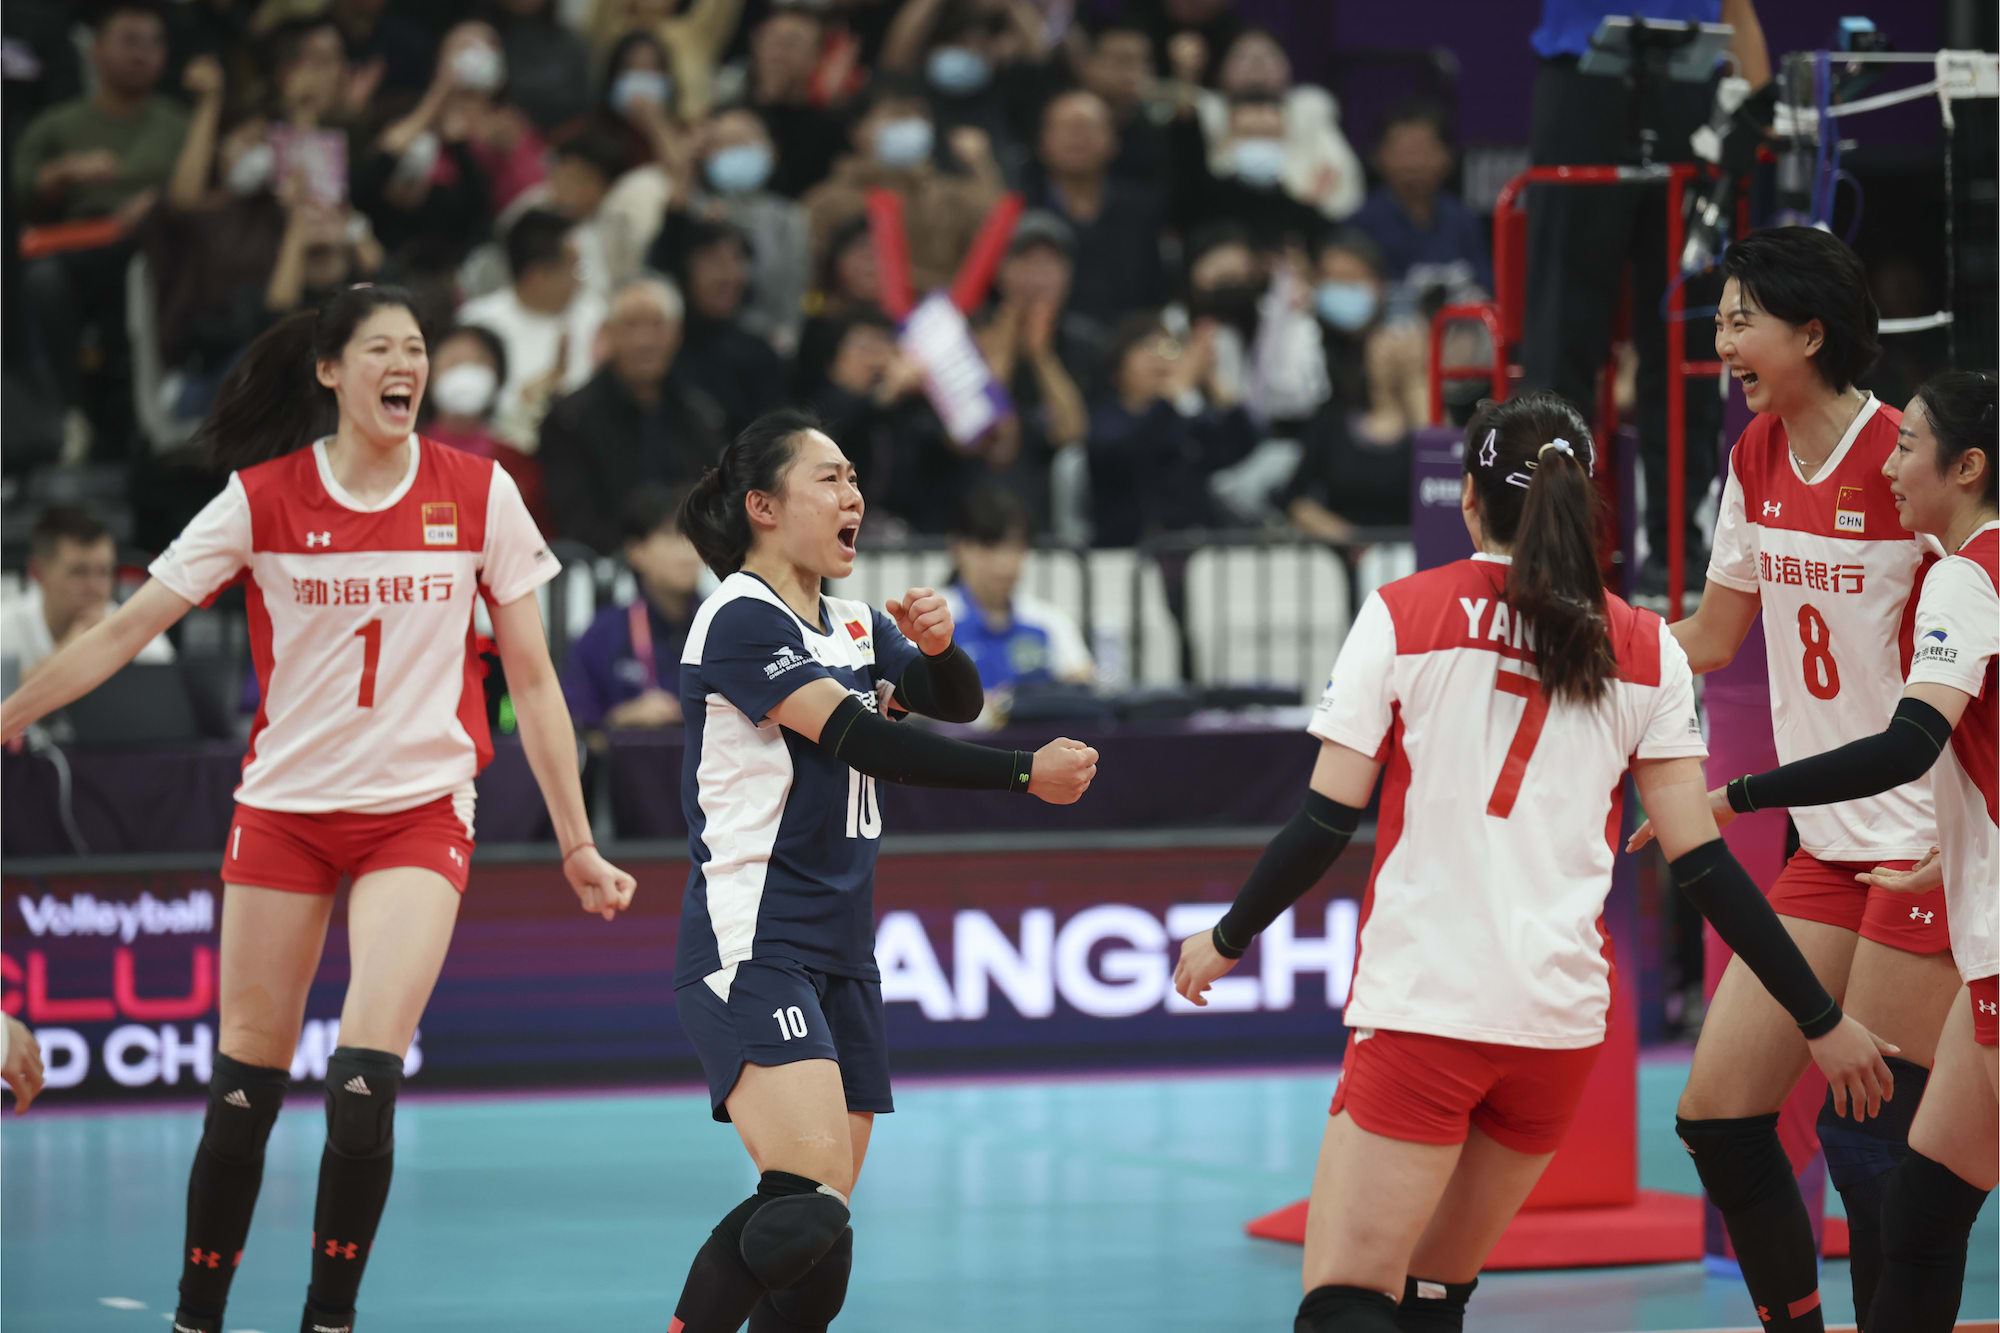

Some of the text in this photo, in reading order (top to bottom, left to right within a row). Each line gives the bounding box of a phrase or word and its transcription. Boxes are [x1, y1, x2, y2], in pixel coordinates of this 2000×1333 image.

[427, 530, 454, 539] CHN
[1838, 515, 1862, 528] CHN
[292, 573, 453, 606] 渤海银行
[856, 641, 871, 652] HN
[1459, 597, 1538, 653] YAN
[354, 619, 382, 708] 1
[763, 655, 805, 676] 渤海银
[1798, 603, 1840, 700] 8
[769, 668, 787, 680] CHINA
[1486, 669, 1553, 819] 7
[846, 765, 882, 840] 10
[232, 825, 242, 860] 1
[18, 889, 214, 943] Volleyball
[873, 900, 1360, 1020] ANGZH
[1, 946, 220, 1022] LU
[772, 1006, 808, 1041] 10
